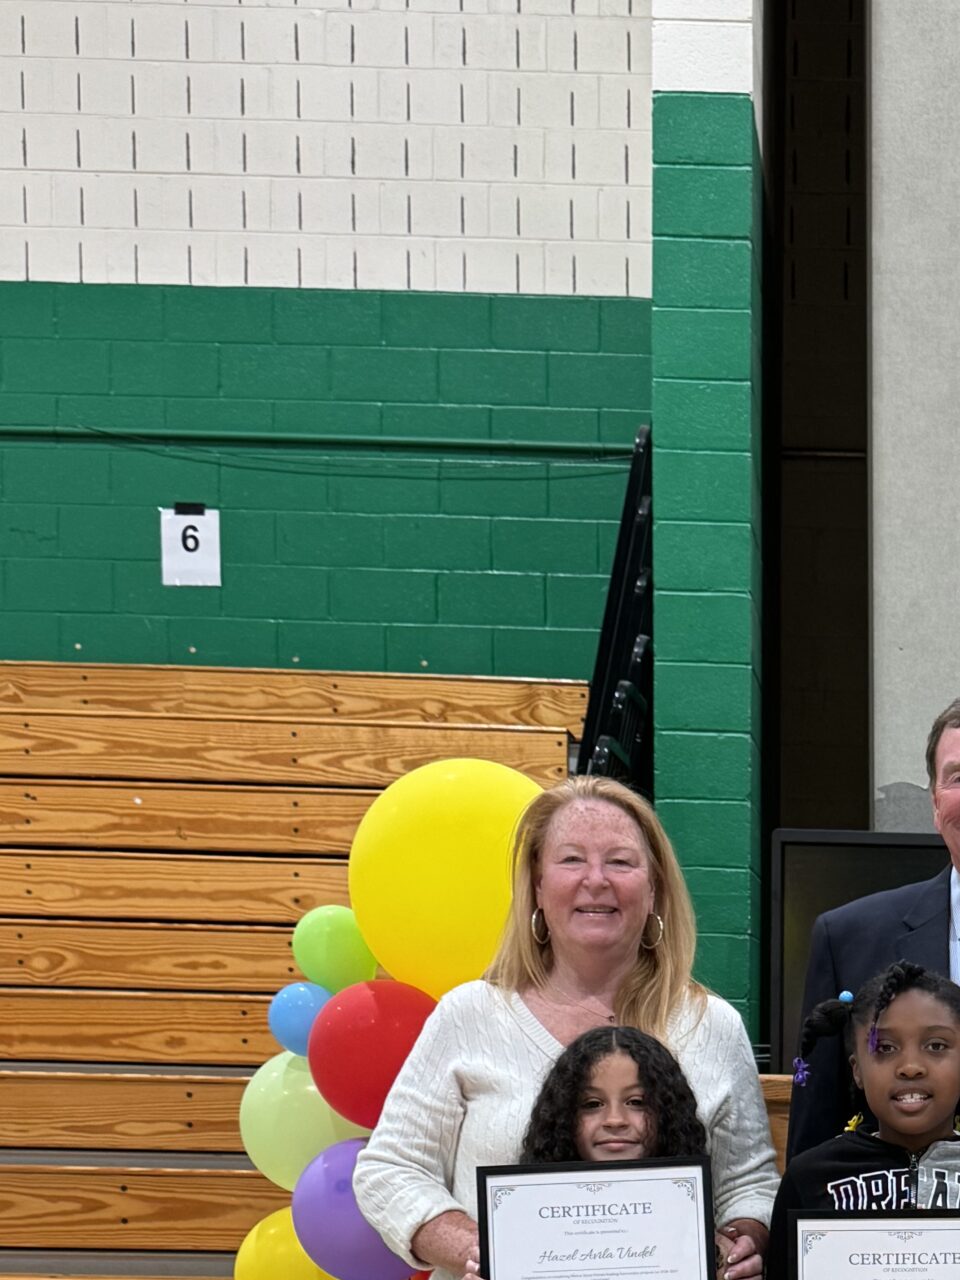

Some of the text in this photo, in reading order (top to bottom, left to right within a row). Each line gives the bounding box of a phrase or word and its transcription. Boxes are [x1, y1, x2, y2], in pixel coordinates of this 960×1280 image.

[181, 524, 200, 553] 6
[538, 1202, 653, 1219] CERTIFICATE
[538, 1245, 657, 1264] Hazel Avila Vindel
